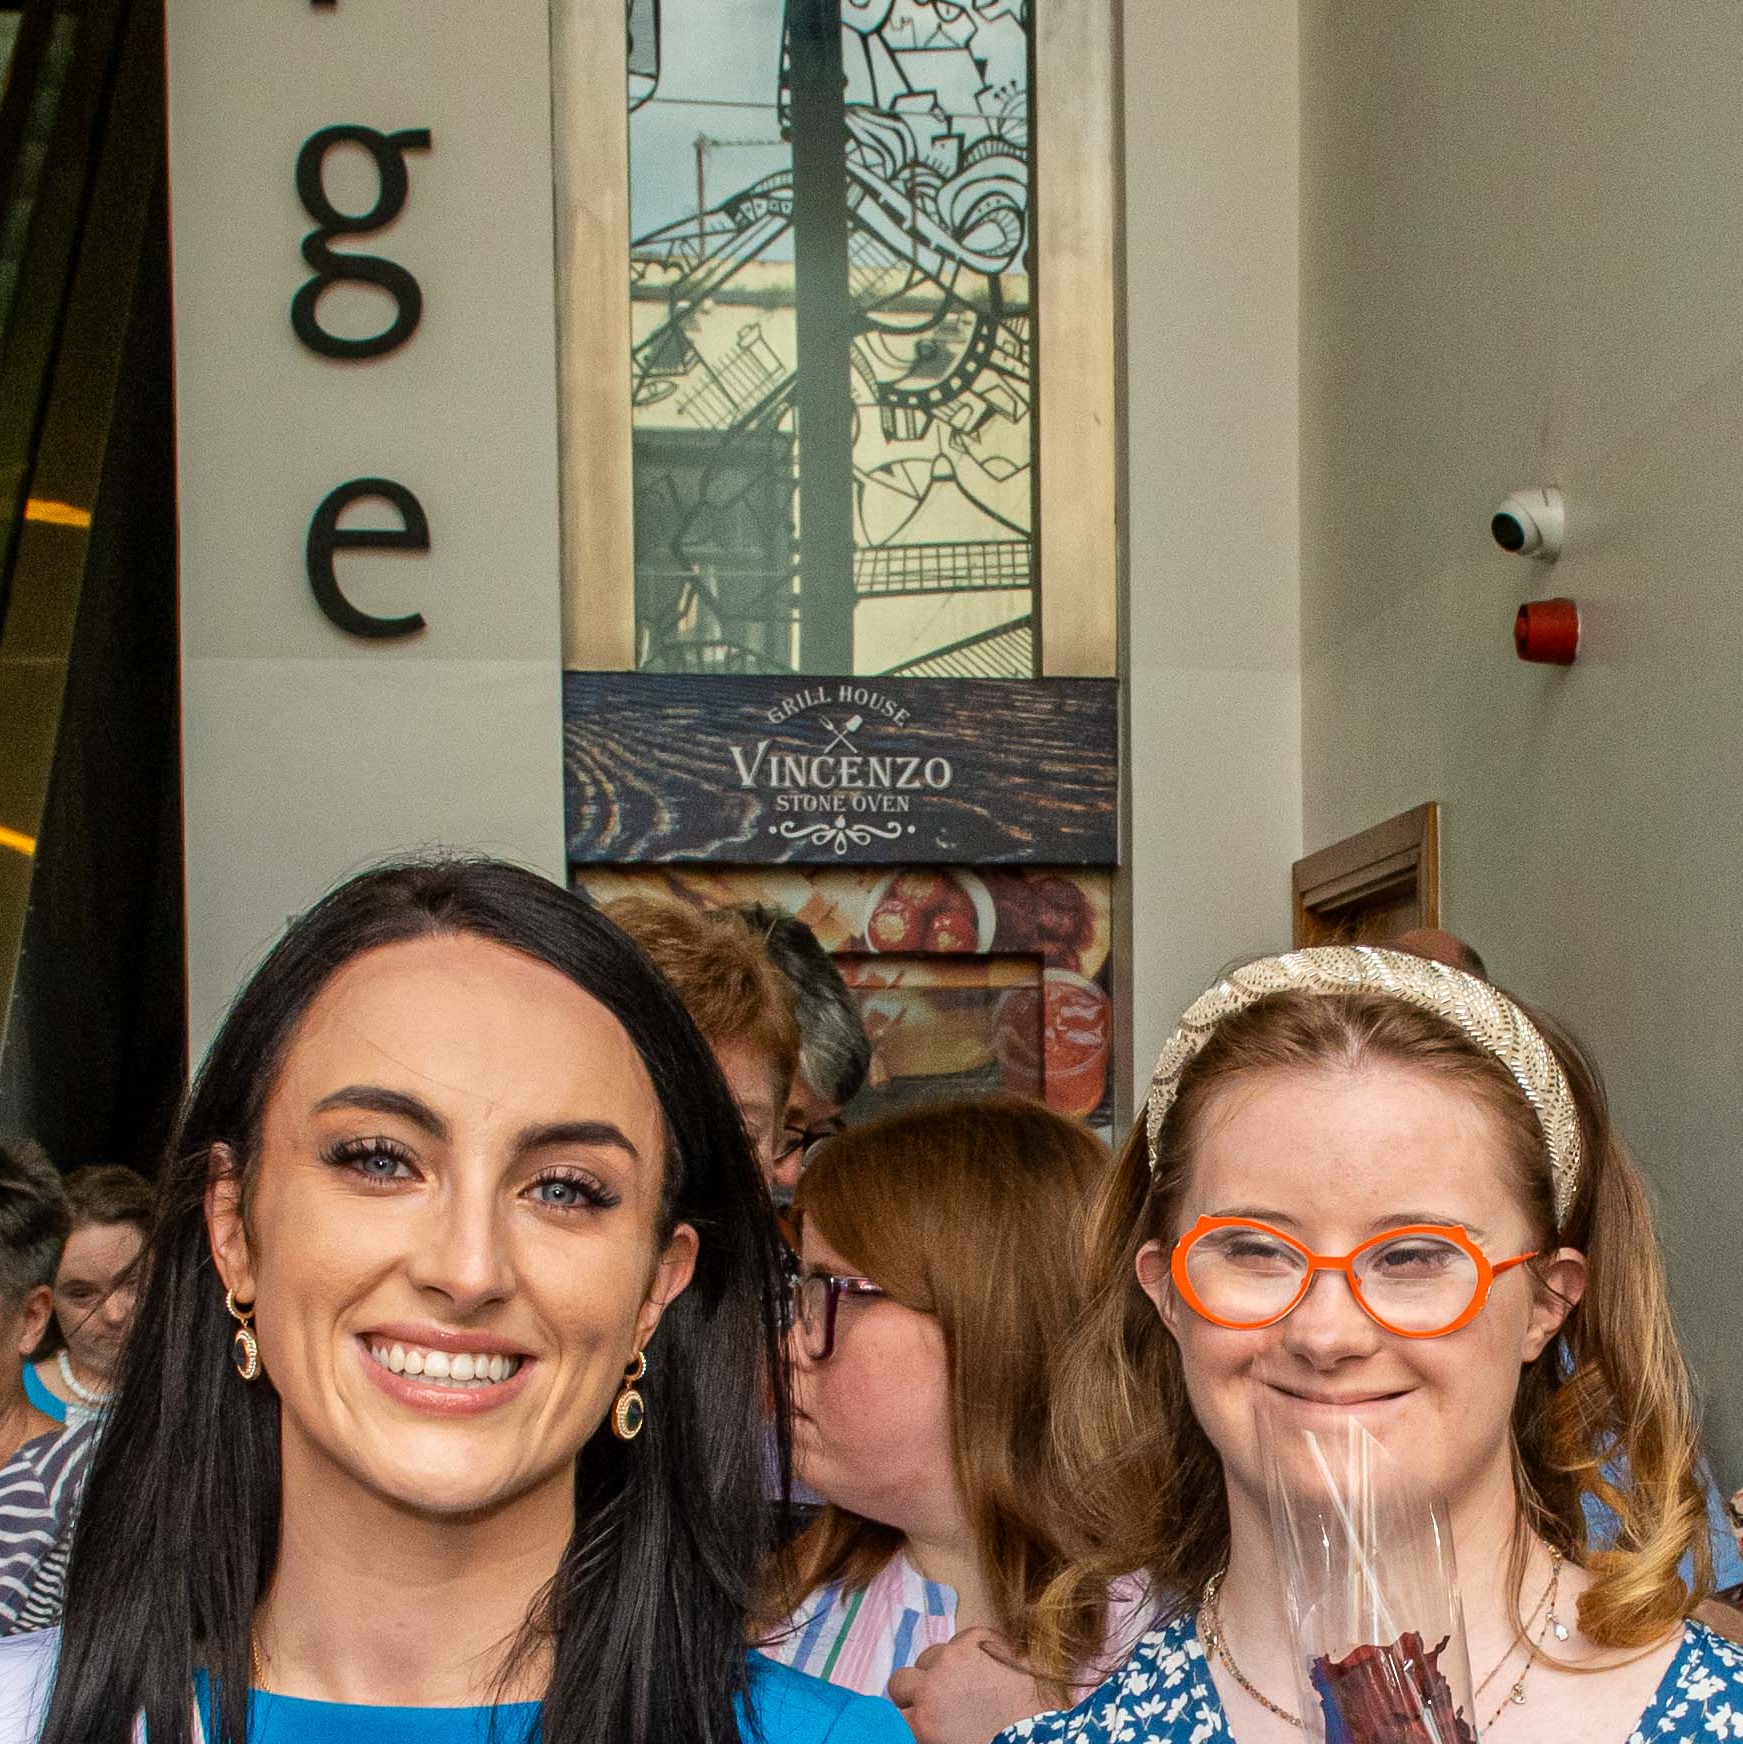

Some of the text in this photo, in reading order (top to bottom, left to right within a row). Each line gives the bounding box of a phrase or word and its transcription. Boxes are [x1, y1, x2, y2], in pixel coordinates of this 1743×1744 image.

[290, 0, 431, 642] ge
[768, 685, 911, 727] GRILL HOUSE
[729, 739, 953, 789] VINCENZO
[775, 794, 910, 813] STONE OVEN
